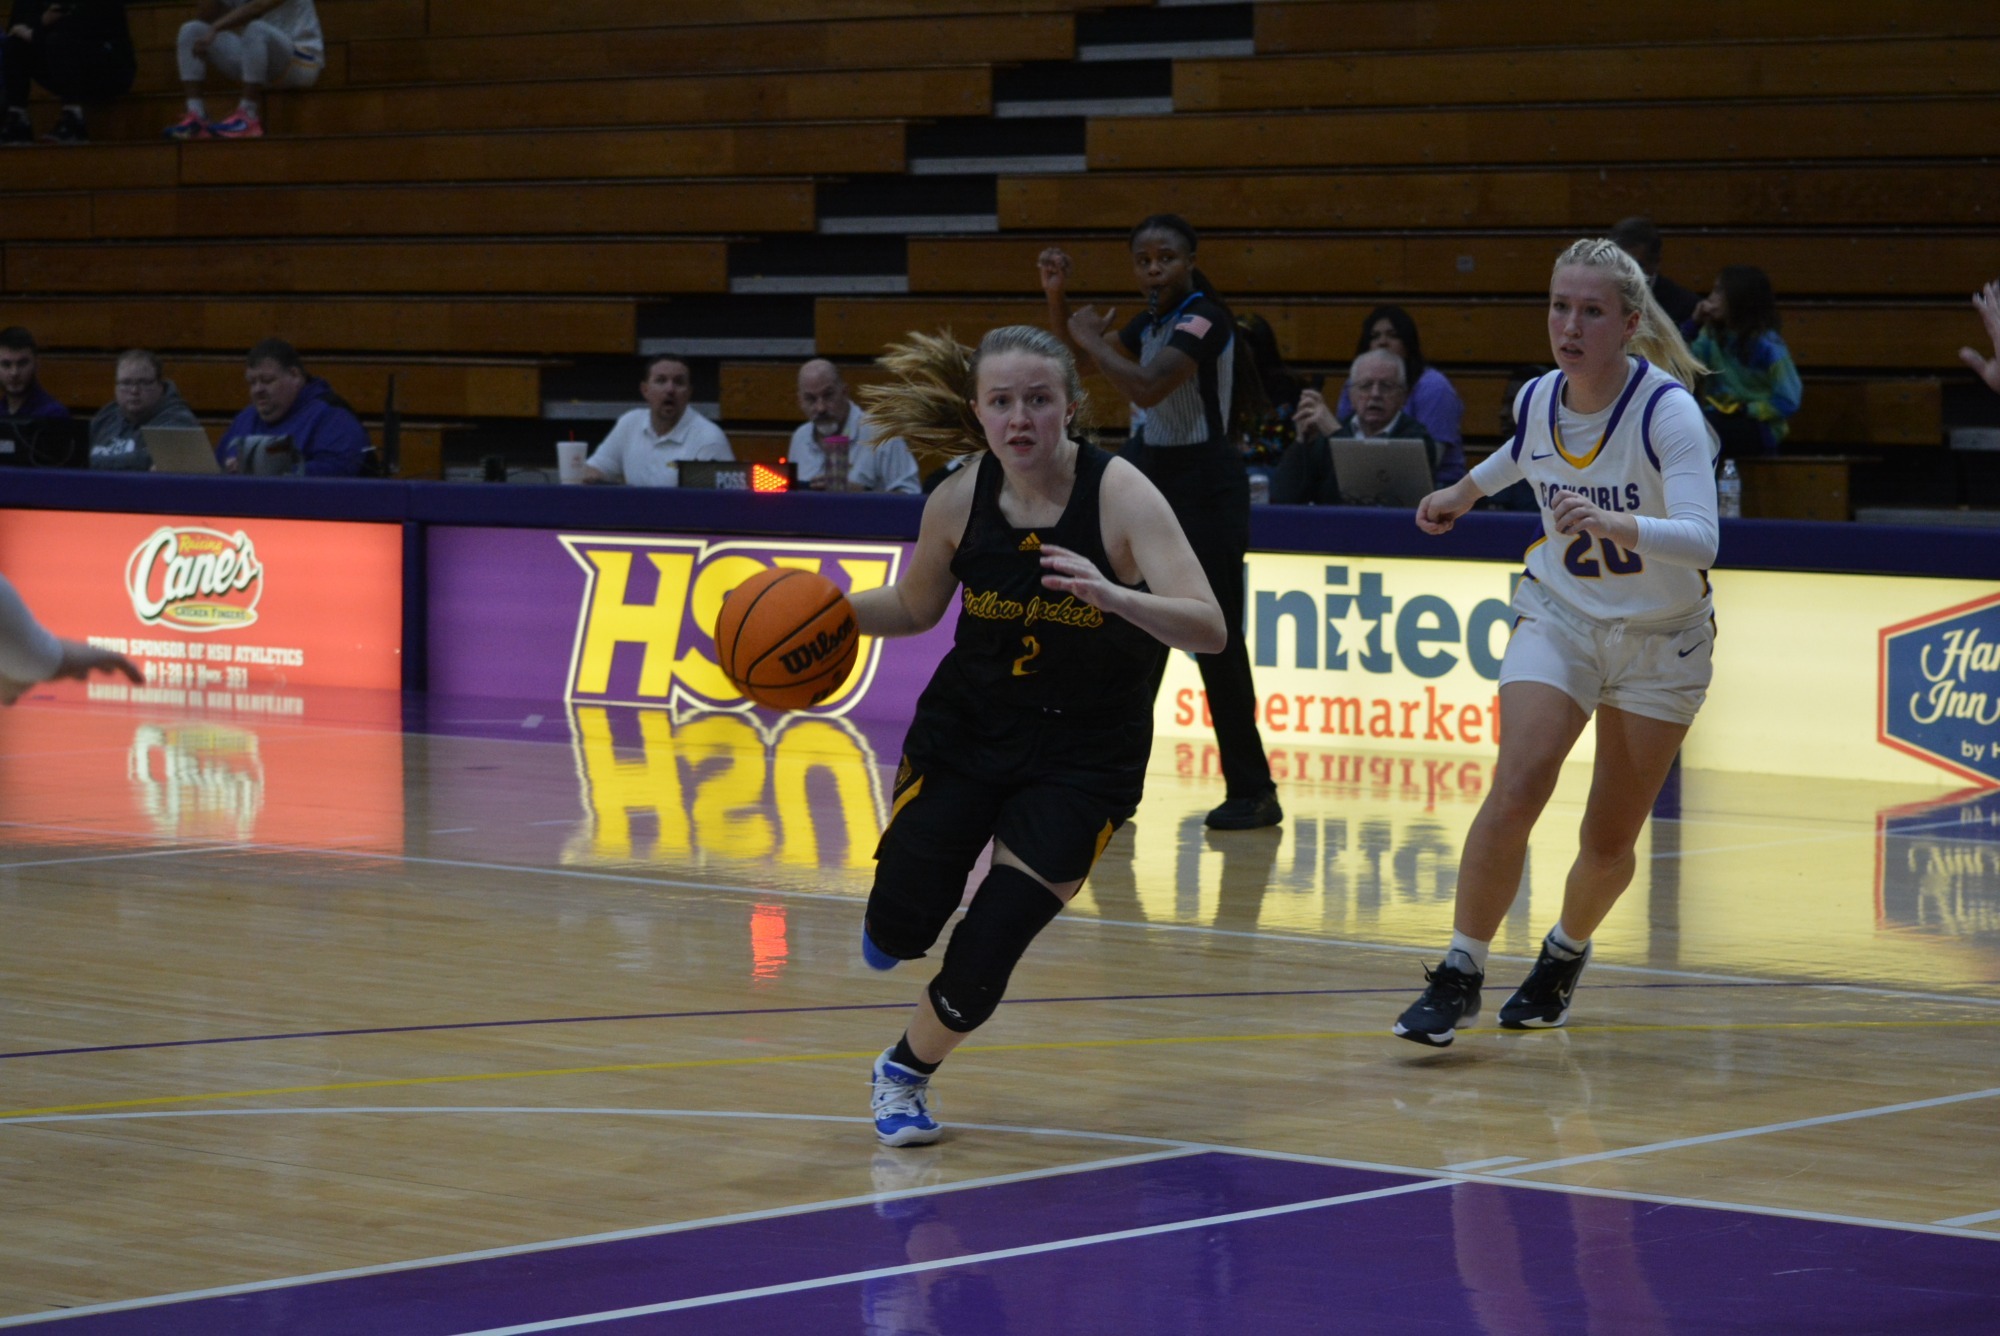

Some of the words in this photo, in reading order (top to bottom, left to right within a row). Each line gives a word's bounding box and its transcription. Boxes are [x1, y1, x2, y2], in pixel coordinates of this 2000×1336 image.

[1018, 543, 1041, 551] adida
[134, 529, 262, 620] Cane's
[574, 548, 890, 707] HSU
[1024, 595, 1104, 628] Jackets
[1242, 564, 1526, 681] nited
[130, 638, 186, 659] SPONSOR
[188, 642, 205, 660] OF
[234, 645, 304, 667] ATHLETICS
[778, 613, 856, 675] Wilson
[1011, 635, 1040, 676] 2
[1909, 679, 2000, 725] Inn
[1961, 740, 1986, 762] by
